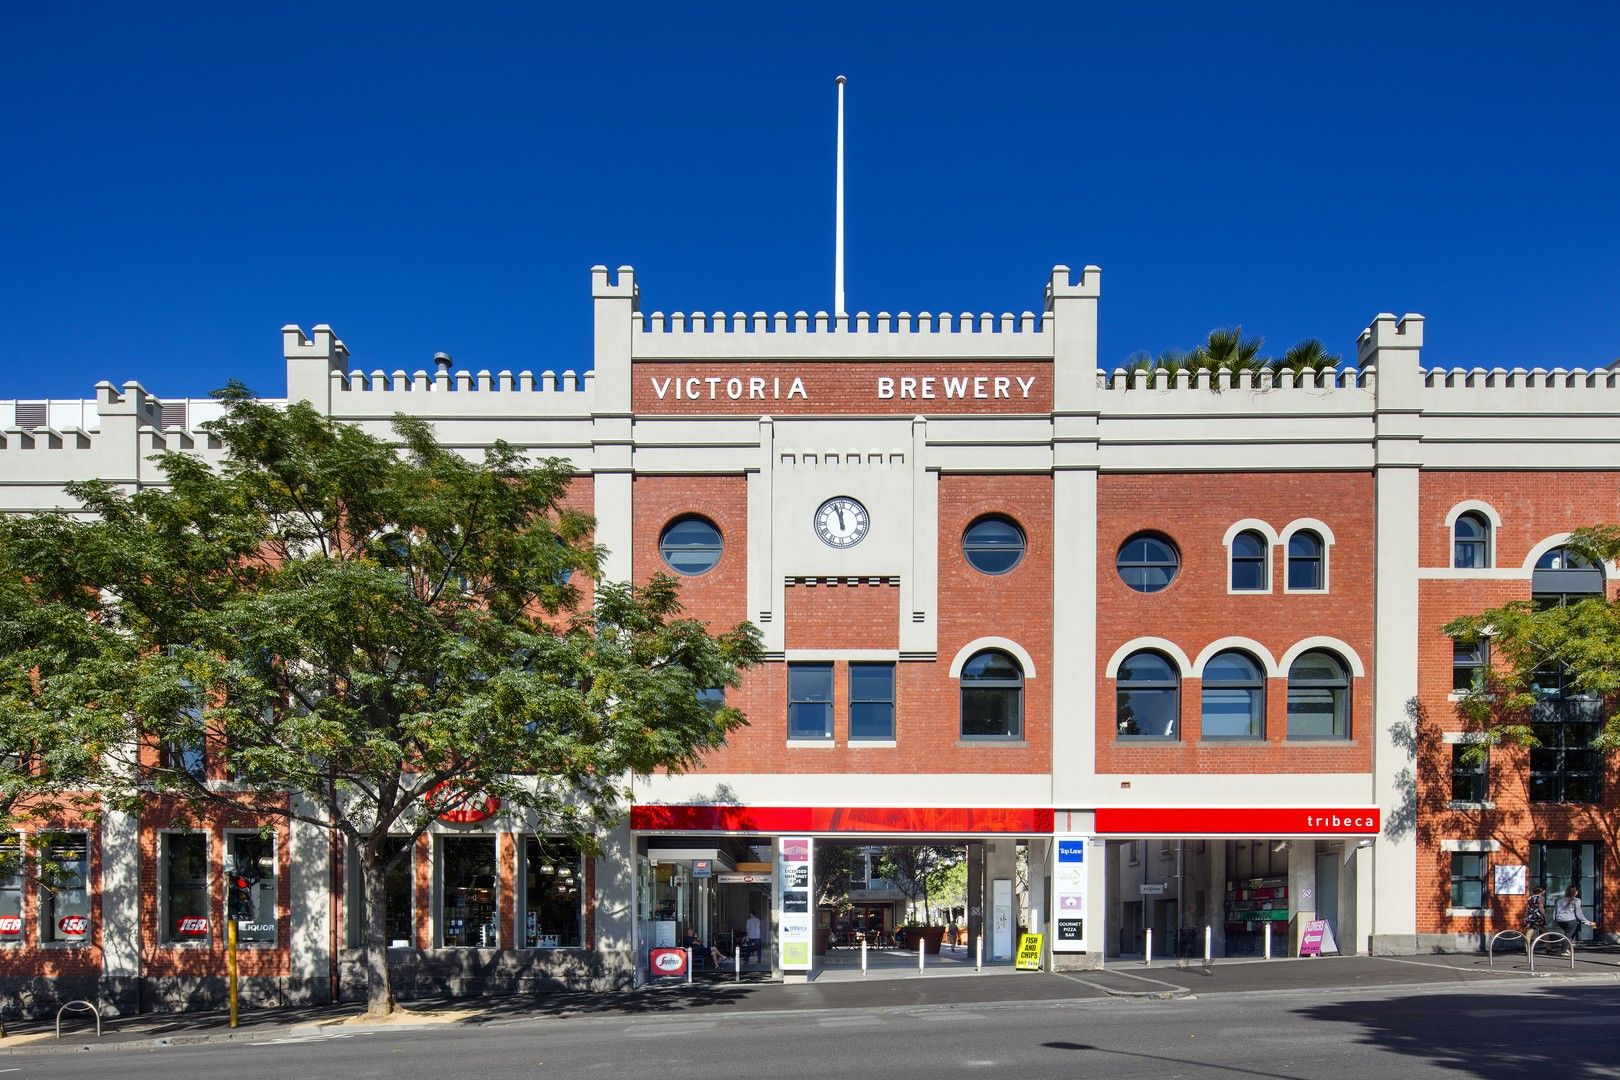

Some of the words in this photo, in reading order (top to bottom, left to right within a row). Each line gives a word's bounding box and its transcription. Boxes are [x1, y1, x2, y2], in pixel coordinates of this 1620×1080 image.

[650, 377, 808, 400] VICTORIA
[878, 376, 1036, 400] BREWERY
[1307, 815, 1374, 827] tribeca
[61, 918, 88, 931] IGA
[180, 918, 207, 931] IGA
[1025, 936, 1038, 944] FISH
[1020, 951, 1038, 959] CHIPS
